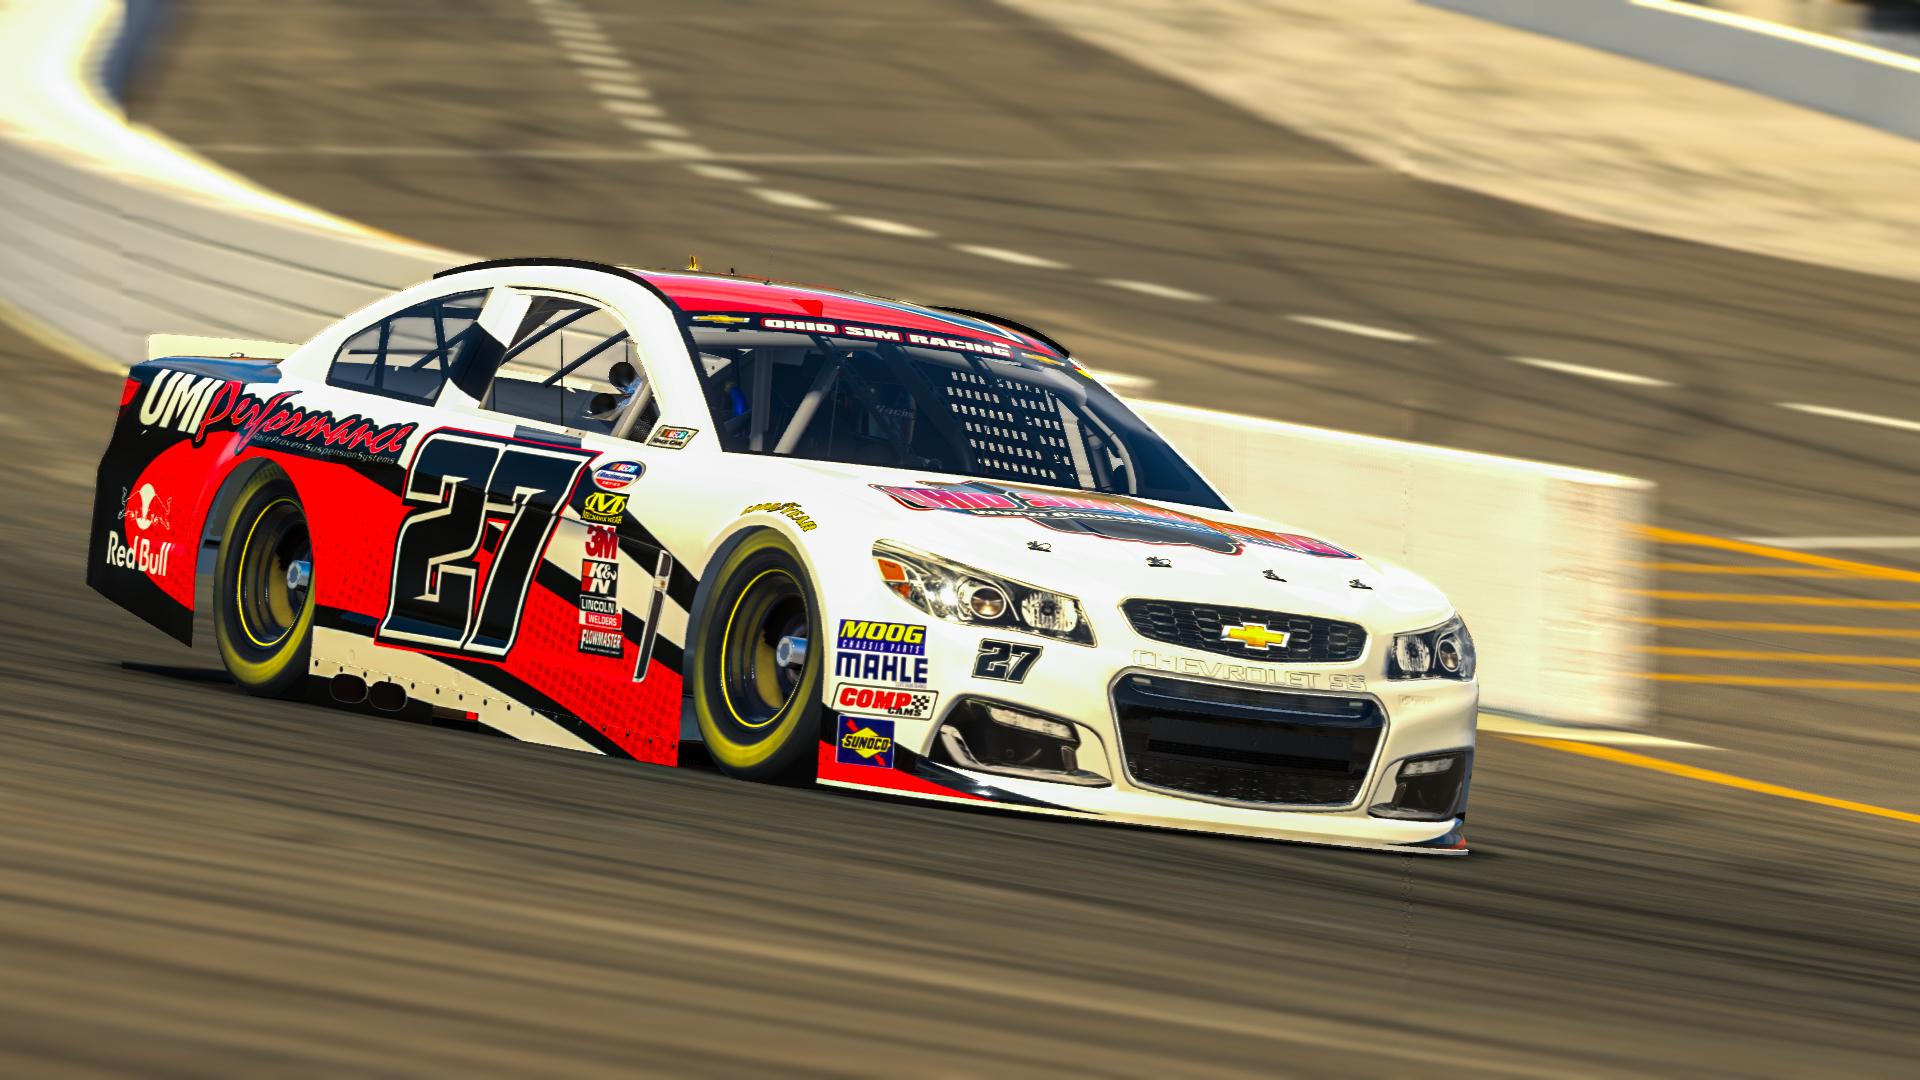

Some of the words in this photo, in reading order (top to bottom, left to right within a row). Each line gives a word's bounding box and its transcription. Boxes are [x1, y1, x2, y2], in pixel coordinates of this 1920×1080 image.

[763, 318, 837, 333] OHIO
[844, 326, 902, 342] SIM
[909, 335, 1012, 357] RACING
[139, 368, 225, 434] UMI
[196, 380, 413, 452] Performance
[106, 530, 136, 570] Red
[137, 537, 172, 576] Bull
[376, 428, 600, 660] 27
[585, 524, 618, 560] 3M
[581, 598, 614, 614] LINCOLN
[588, 614, 617, 627] WELDERS
[840, 621, 925, 644] MOOG
[581, 629, 622, 650] FLOWMASTER
[842, 639, 885, 651] CHASSIS
[890, 643, 921, 654] PARTS
[835, 651, 928, 683] MAHLE
[971, 638, 1043, 684] 27
[1133, 650, 1321, 689] CHEVROLET
[1328, 673, 1368, 692] SS
[839, 687, 912, 710] COMP
[887, 707, 922, 717] CAMS
[844, 735, 890, 751] SUNOCO
